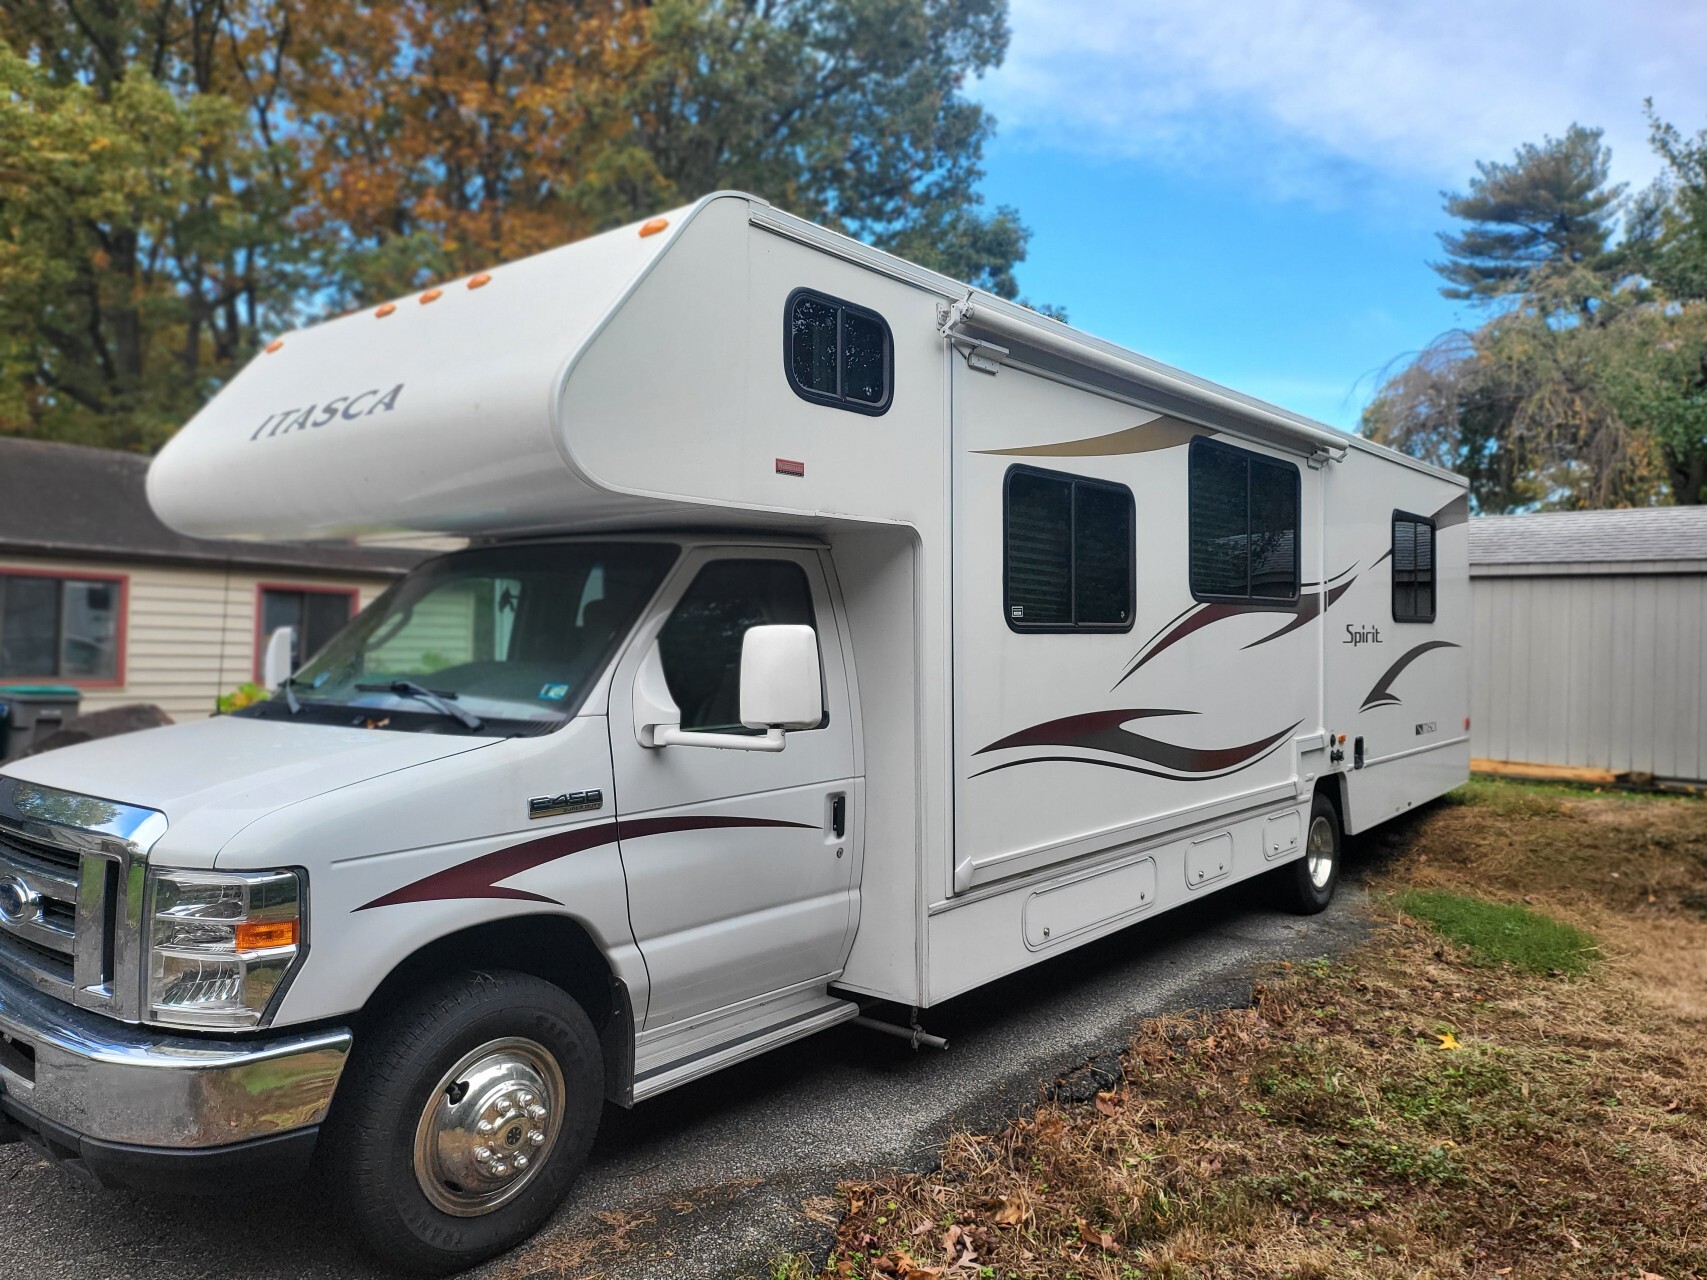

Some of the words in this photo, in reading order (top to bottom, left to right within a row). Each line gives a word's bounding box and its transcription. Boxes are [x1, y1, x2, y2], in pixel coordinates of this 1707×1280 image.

[250, 383, 404, 441] ITASCA
[1343, 624, 1383, 647] Spirit
[529, 789, 602, 812] E-450
